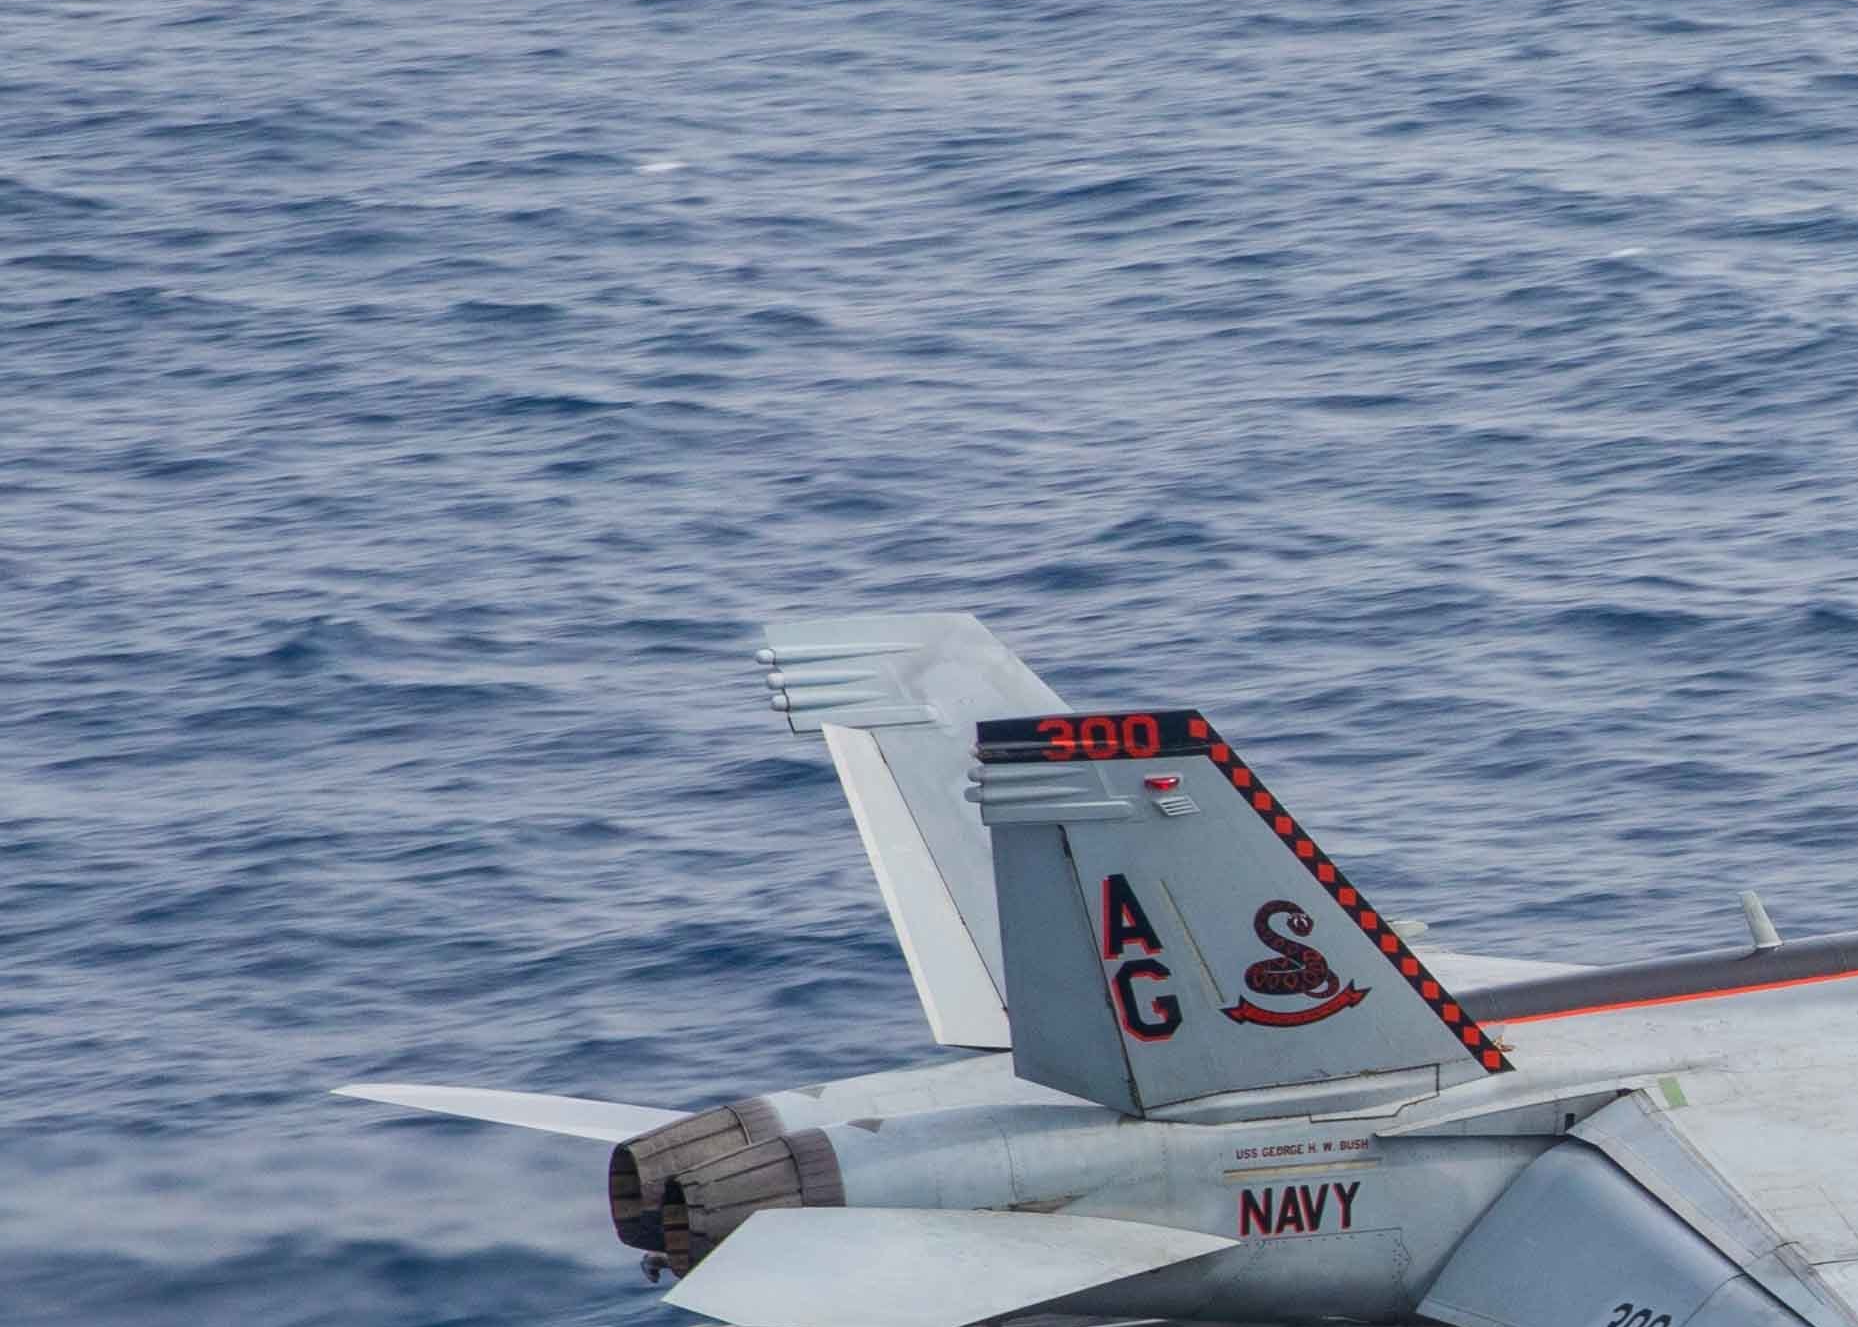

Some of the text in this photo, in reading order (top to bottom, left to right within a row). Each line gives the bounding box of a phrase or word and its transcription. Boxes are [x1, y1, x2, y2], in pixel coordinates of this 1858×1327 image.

[1036, 713, 1162, 762] 300
[1235, 1147, 1258, 1160] USS
[1261, 1143, 1305, 1158] GEORGE
[1339, 1138, 1370, 1152] BUSH
[1239, 1181, 1362, 1238] NAVY
